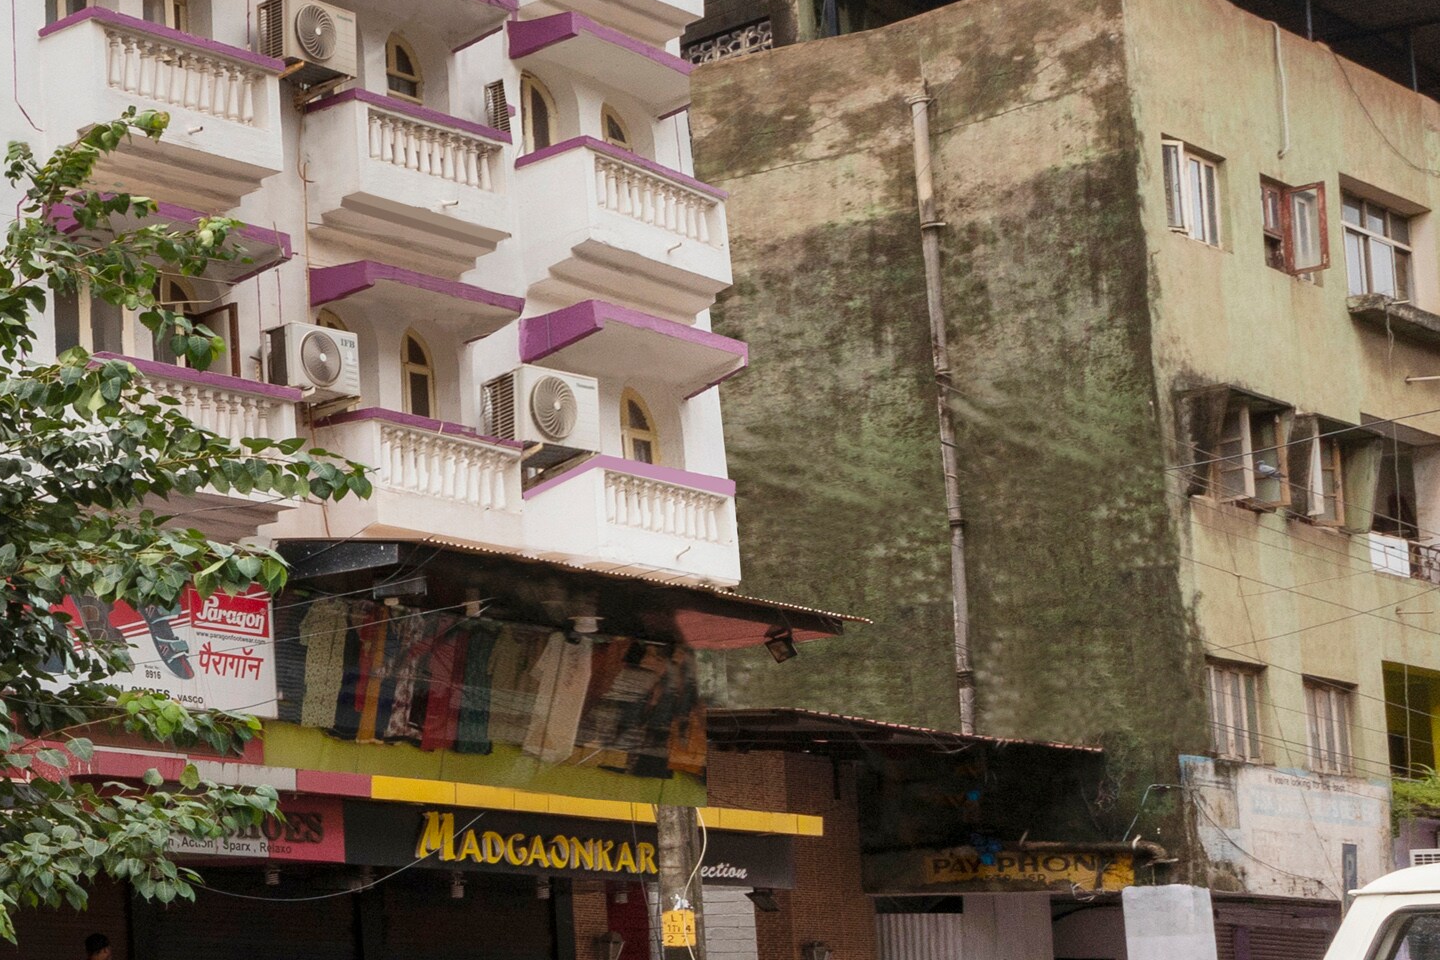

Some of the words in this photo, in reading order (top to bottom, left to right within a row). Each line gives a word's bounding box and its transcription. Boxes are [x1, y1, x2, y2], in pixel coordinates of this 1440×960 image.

[341, 339, 355, 349] IFB
[196, 595, 265, 634] Paragon
[199, 641, 264, 680] पैरागॉन
[145, 669, 161, 680] 8916
[177, 694, 203, 704] VASCO
[260, 841, 292, 854] Relaxo
[700, 862, 748, 880] ection
[932, 857, 981, 875] PAY
